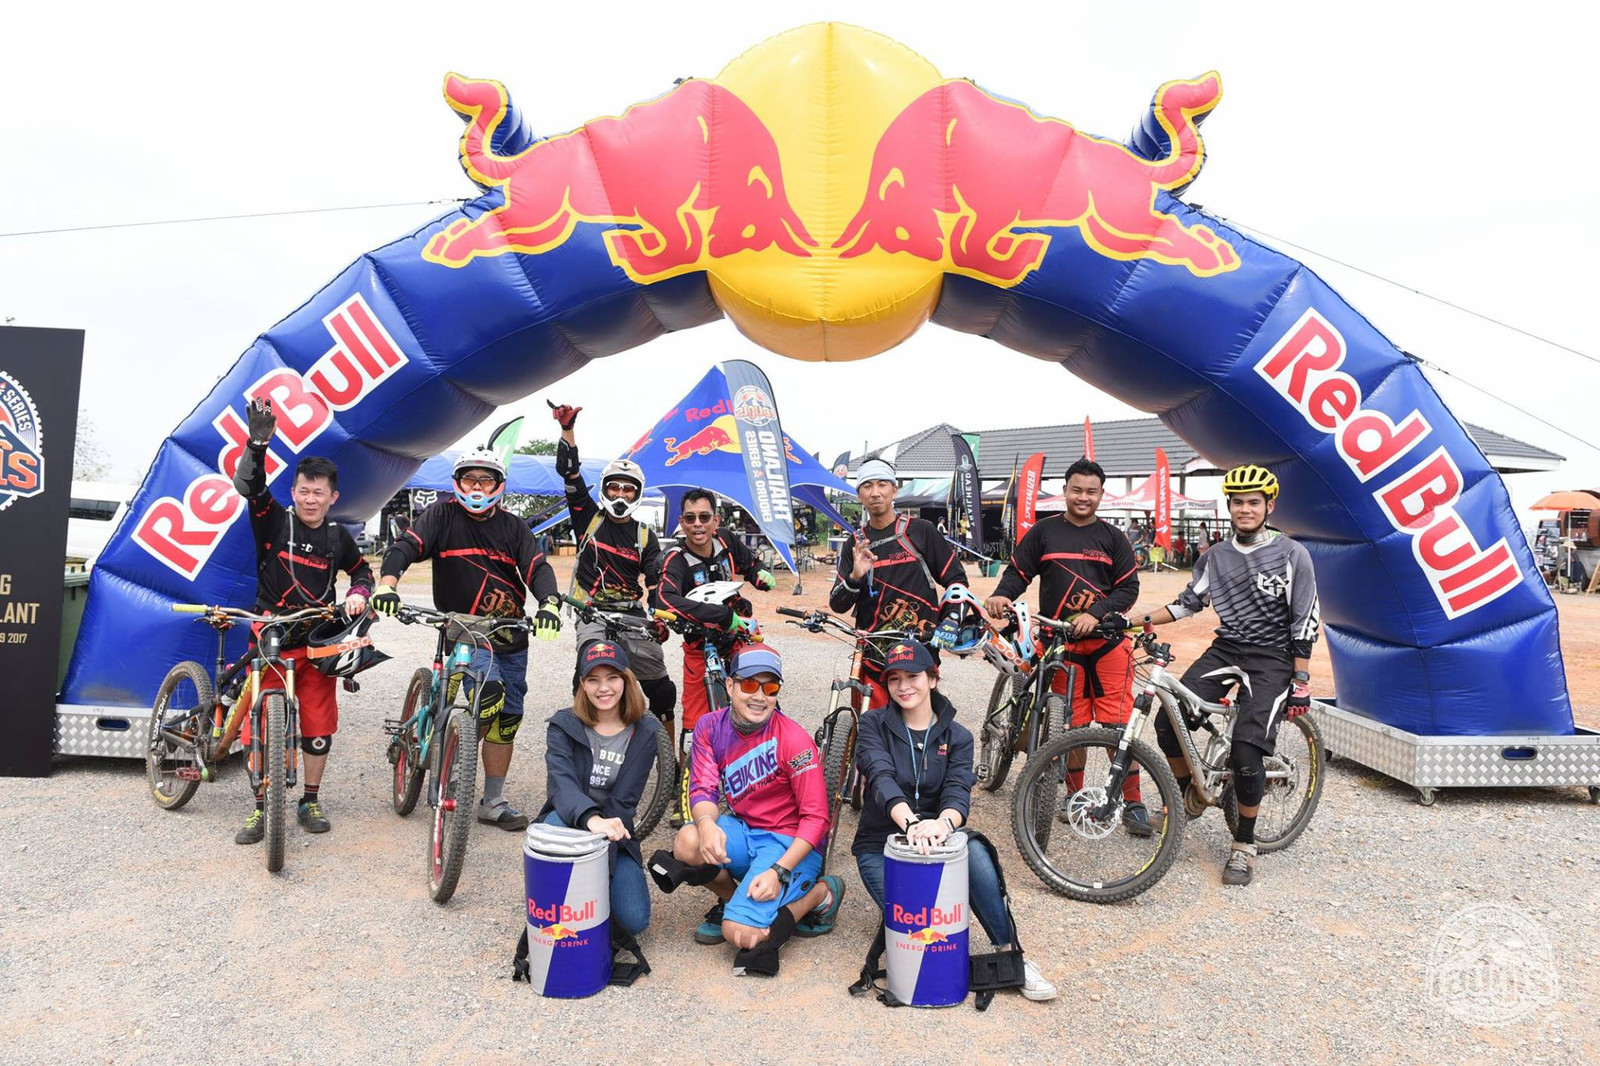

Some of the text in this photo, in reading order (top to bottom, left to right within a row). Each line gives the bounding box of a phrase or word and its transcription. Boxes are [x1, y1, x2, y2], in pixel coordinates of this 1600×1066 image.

[3, 389, 32, 431] SERIES
[685, 399, 725, 423] Red
[134, 297, 404, 580] Red Bull
[1258, 311, 1521, 616] Red Bull
[1024, 469, 1036, 521] SPECIALIZED
[7, 633, 28, 644] 2017
[586, 650, 615, 661] Red Bull
[900, 653, 914, 661] Bull
[592, 764, 611, 776] NCE
[528, 898, 594, 923] Red Bull
[893, 904, 962, 926] Red Bull
[530, 935, 588, 948] ENERGY DRINK
[896, 941, 958, 953] ENERGY DRINK
